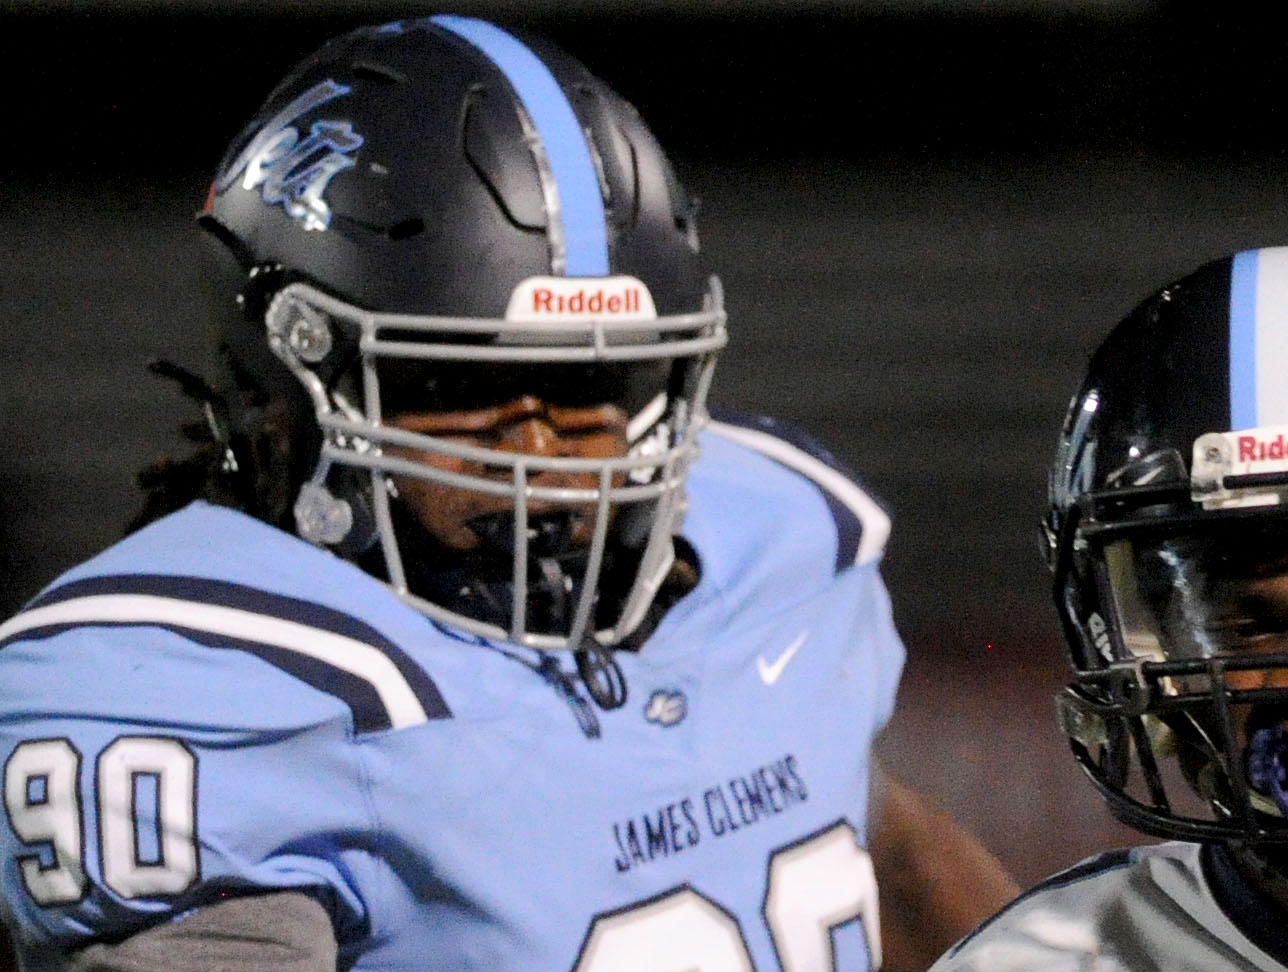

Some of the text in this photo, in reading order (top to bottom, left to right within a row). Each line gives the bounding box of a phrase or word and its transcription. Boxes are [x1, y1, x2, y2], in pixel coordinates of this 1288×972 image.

[533, 287, 641, 314] Riddell
[3, 735, 201, 908] 90
[613, 754, 808, 872] JAMES CLEMENS
